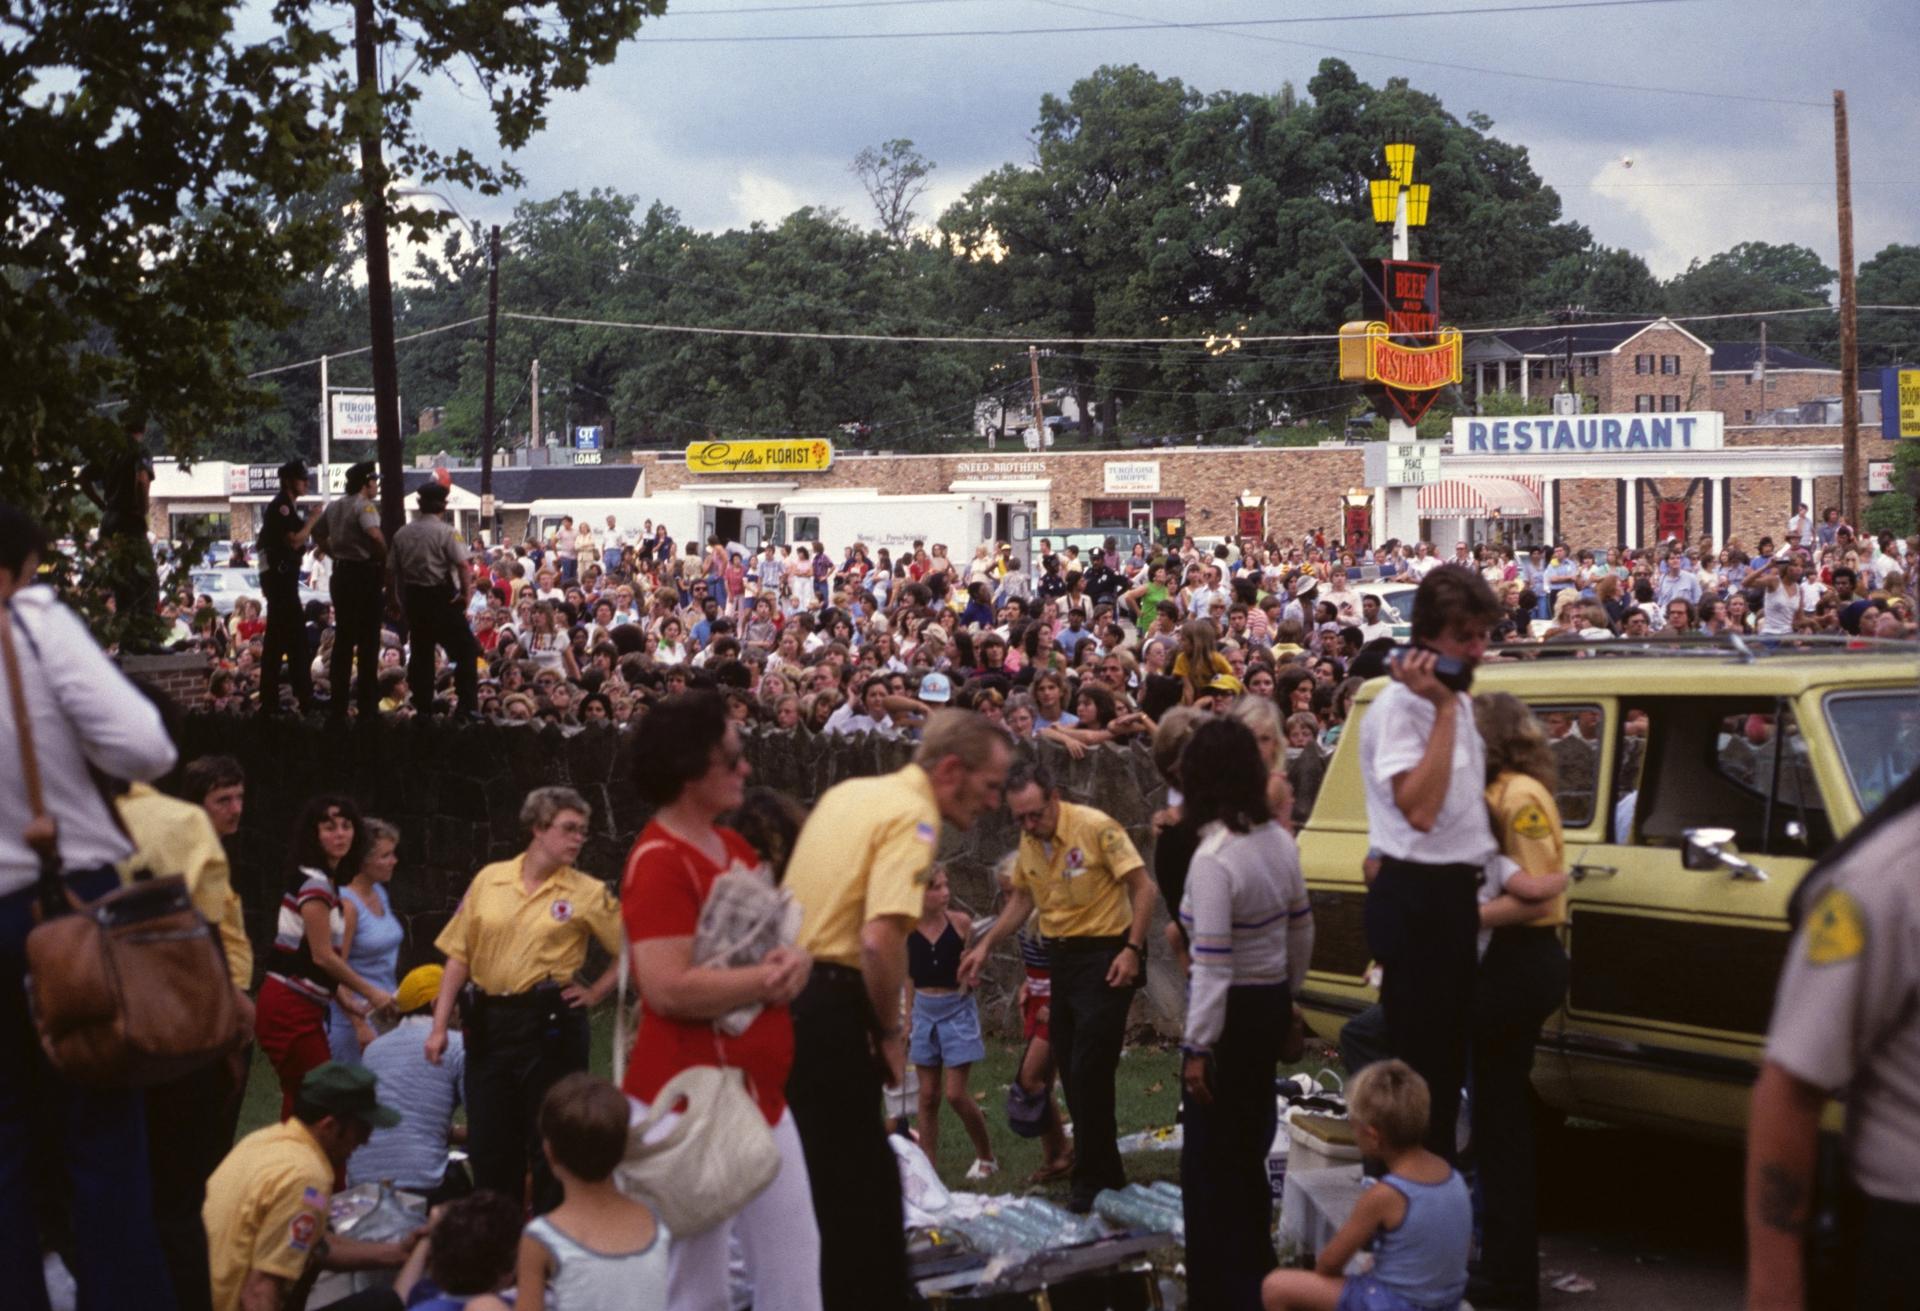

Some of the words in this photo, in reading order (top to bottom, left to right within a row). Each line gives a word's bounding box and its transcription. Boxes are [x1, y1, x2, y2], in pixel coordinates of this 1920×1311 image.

[1395, 271, 1427, 299] BEEF
[1376, 343, 1454, 387] RESTAURANT
[1468, 417, 1697, 451] RESTAURANT
[765, 448, 809, 464] FLORIST
[1399, 445, 1413, 457] REST
[575, 452, 602, 465] LOANS
[1405, 458, 1422, 469] PEACE
[957, 462, 989, 473] SNEED
[993, 462, 1046, 473] BROTHERS
[1403, 471, 1425, 482] ELVIS
